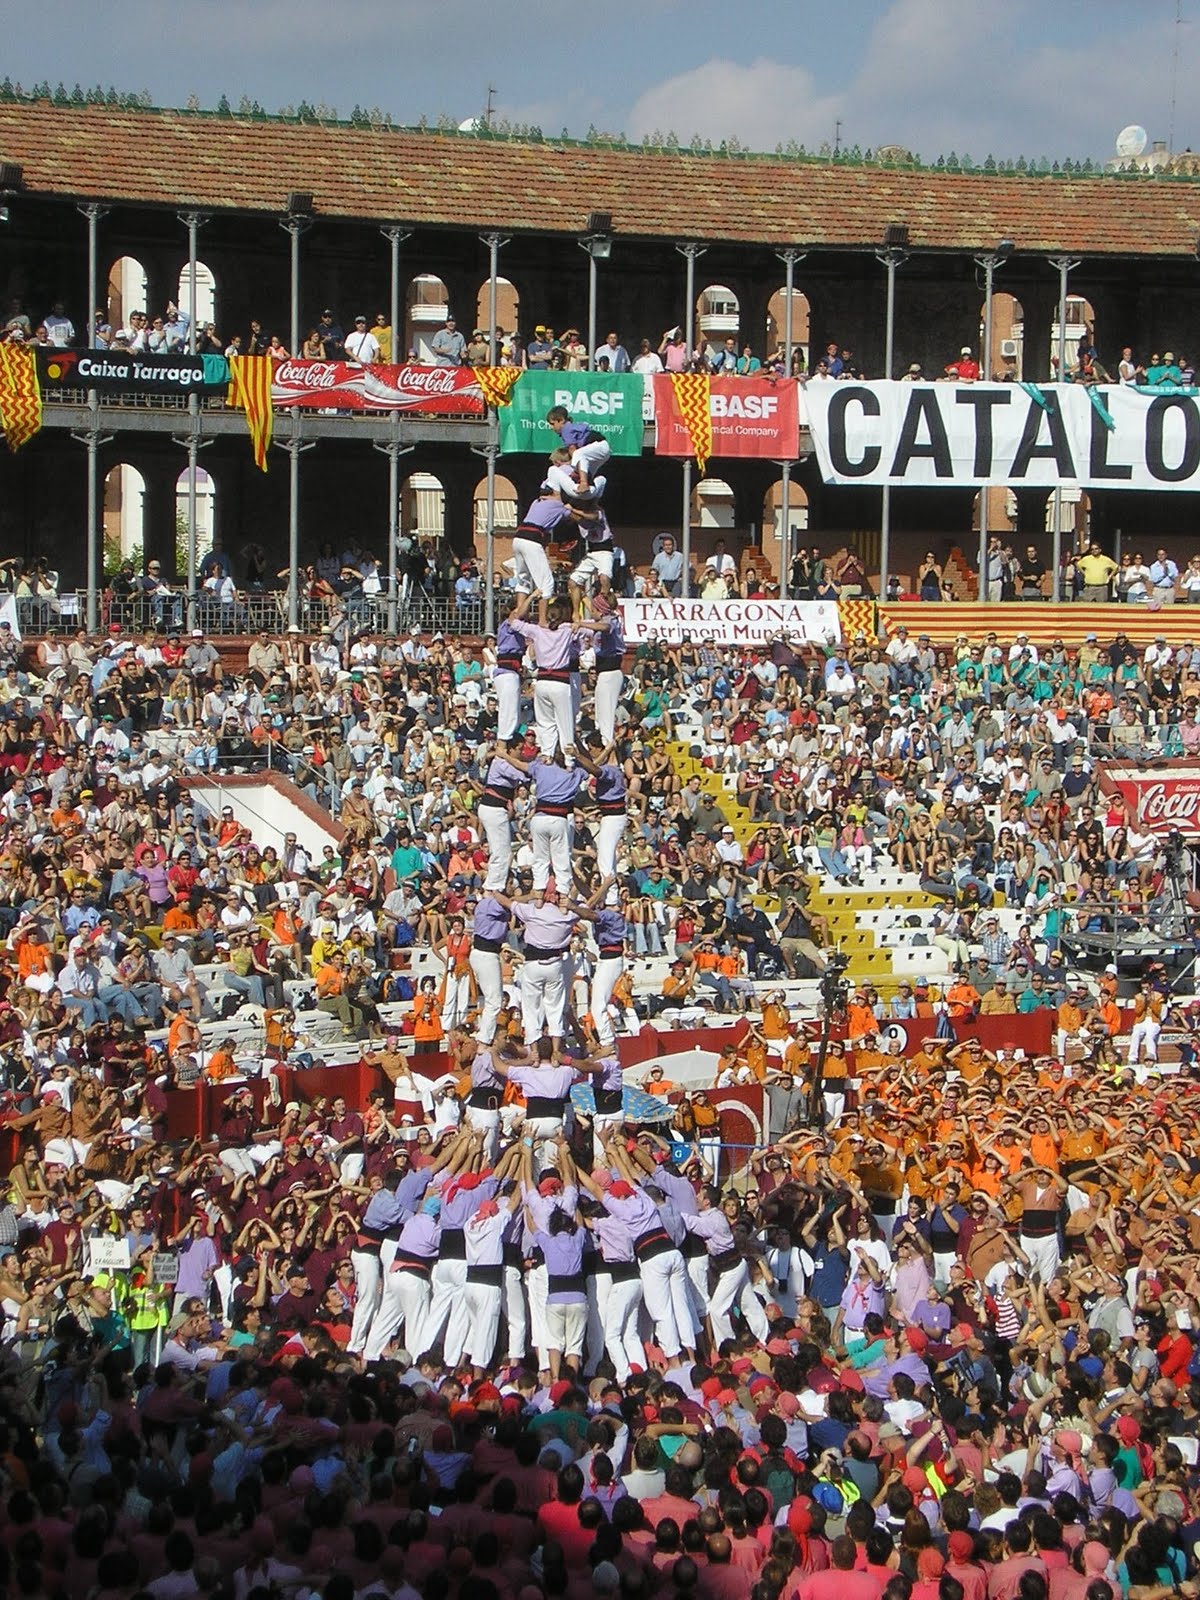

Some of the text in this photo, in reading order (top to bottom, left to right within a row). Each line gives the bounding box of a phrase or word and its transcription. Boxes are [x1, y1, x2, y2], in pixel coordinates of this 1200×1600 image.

[78, 358, 205, 385] Caixa Tarrago
[275, 360, 339, 387] Coca-Cola
[397, 366, 459, 392] Coca-Cola
[554, 390, 624, 415] BASF
[709, 394, 778, 419] BASF
[735, 425, 779, 438] Company
[636, 603, 804, 621] TARRAGONA
[636, 623, 727, 639] Patrimoni
